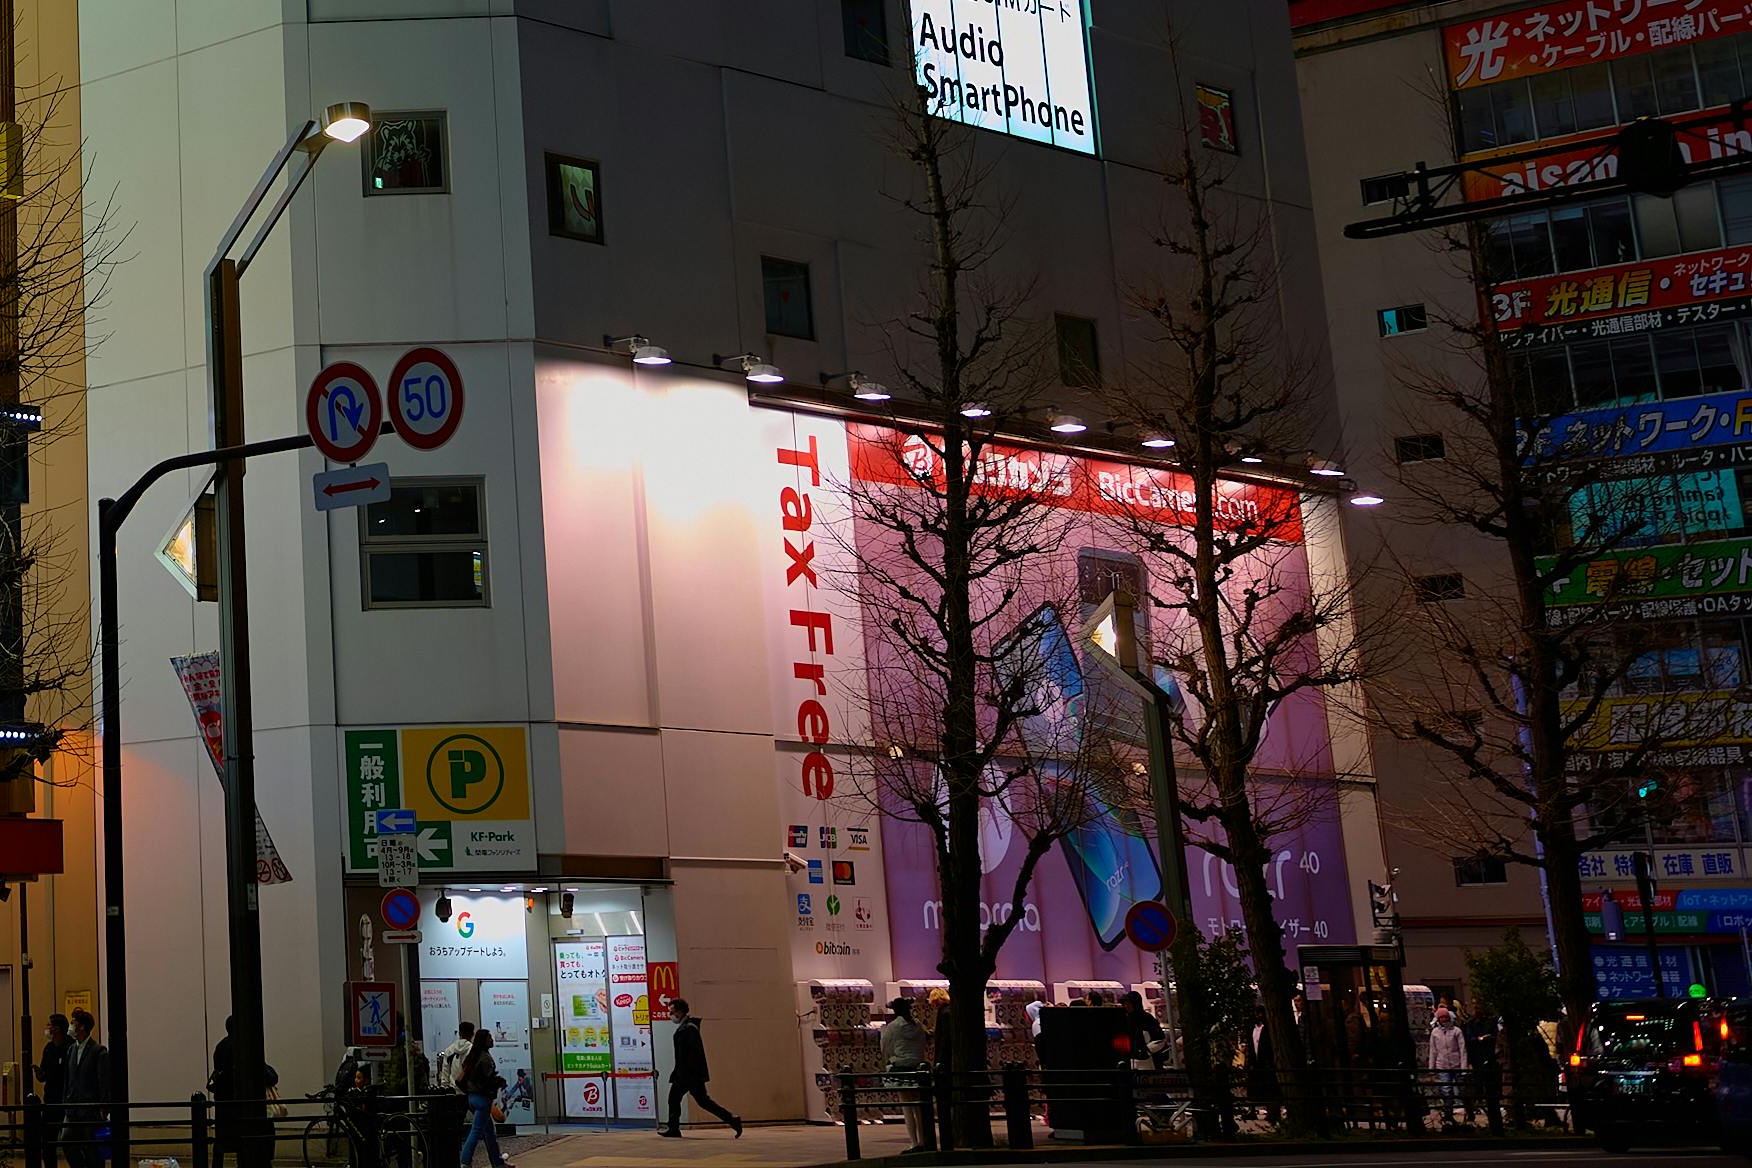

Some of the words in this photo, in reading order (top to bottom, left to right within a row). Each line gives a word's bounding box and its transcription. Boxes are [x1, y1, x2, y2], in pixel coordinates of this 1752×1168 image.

[919, 12, 1005, 68] Audio
[403, 373, 447, 423] 50
[776, 435, 822, 590] Tax
[789, 608, 836, 801] Free
[448, 749, 487, 799] P
[850, 834, 868, 845] VISA
[1299, 850, 1321, 875] 40
[1662, 853, 1694, 876] 在庫
[1701, 852, 1734, 875] 直販
[457, 911, 475, 939] G
[923, 899, 1041, 932] moroa
[1313, 920, 1329, 939] 40
[823, 941, 851, 955] bitcoin
